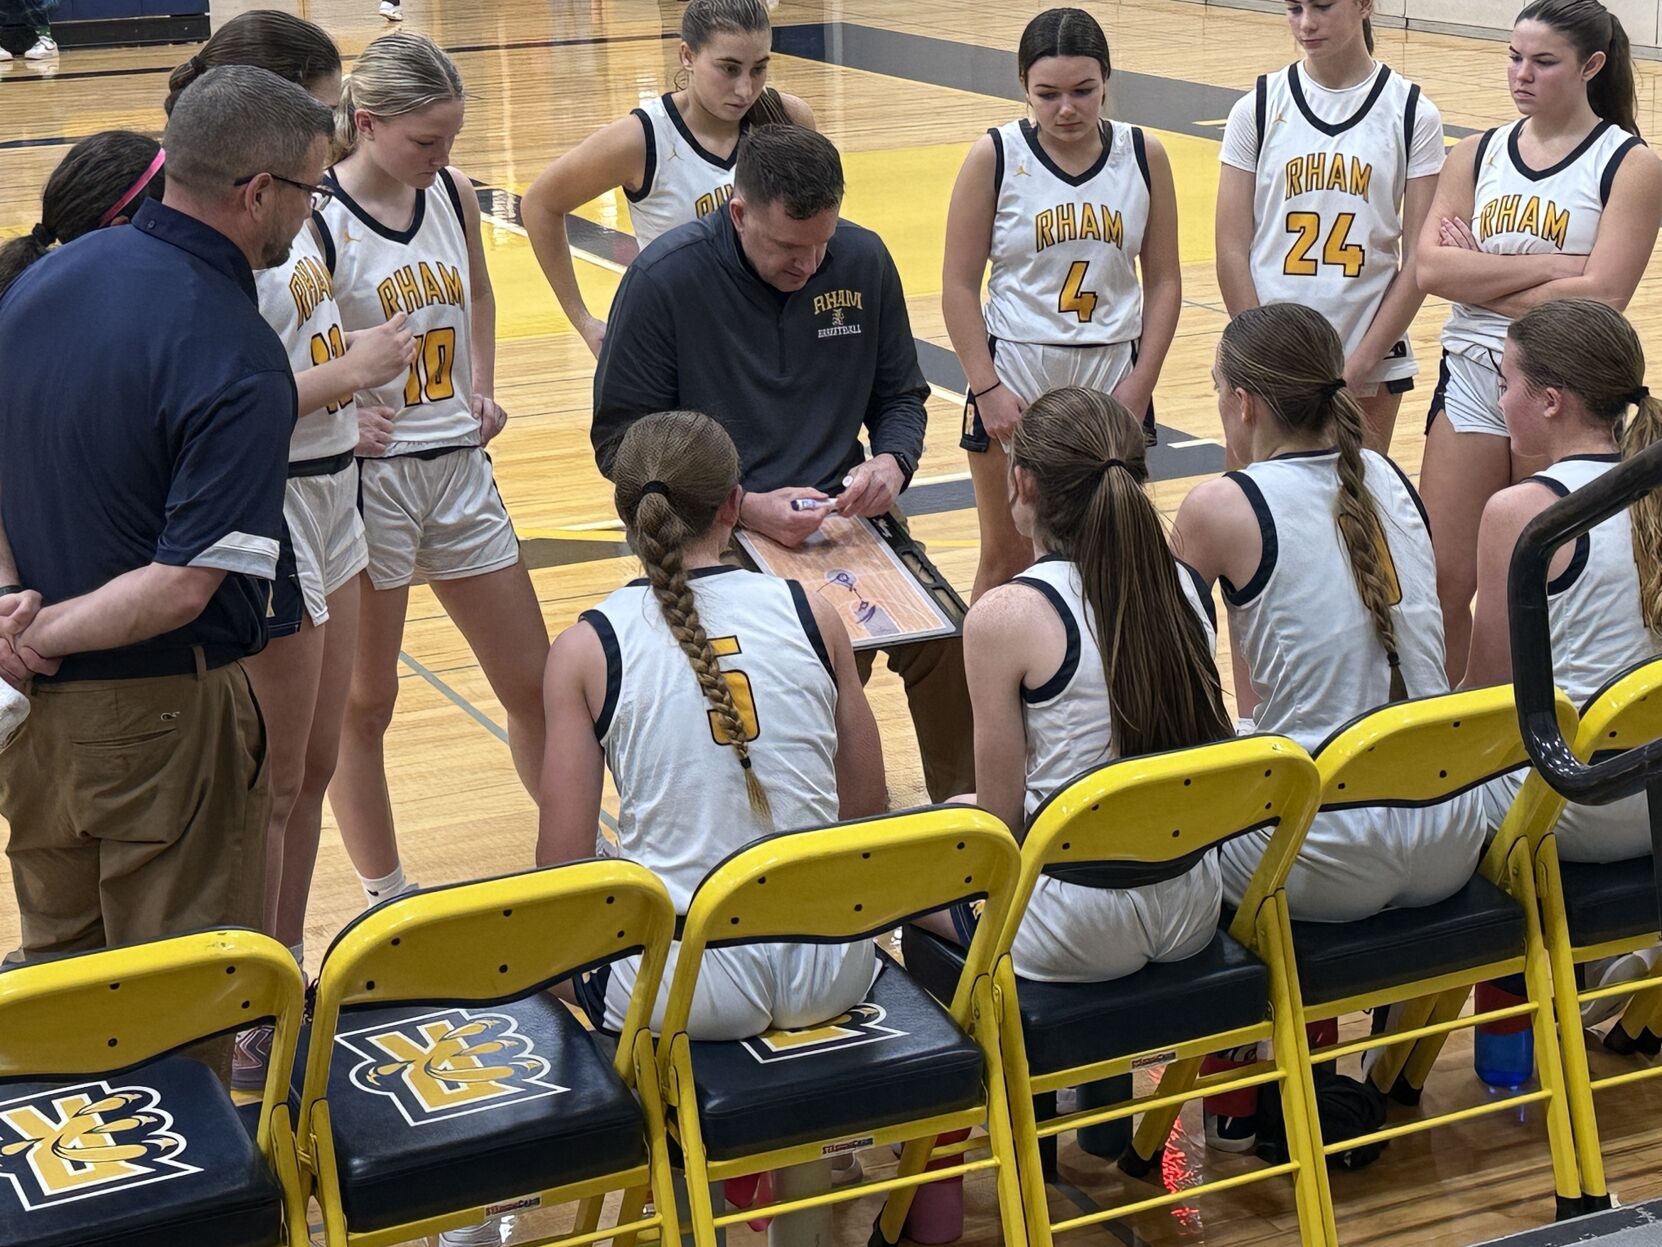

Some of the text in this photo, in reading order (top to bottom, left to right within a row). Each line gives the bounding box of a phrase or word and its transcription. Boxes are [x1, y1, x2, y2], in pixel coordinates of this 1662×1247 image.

[1285, 152, 1372, 203] RHAM
[1036, 202, 1124, 252] RHAM
[1283, 211, 1365, 277] 24
[1480, 194, 1570, 250] RHAM
[289, 255, 334, 331] RHA
[377, 261, 465, 321] RHAM
[813, 289, 863, 315] RHAM
[1058, 261, 1098, 322] 4
[404, 326, 456, 407] 10
